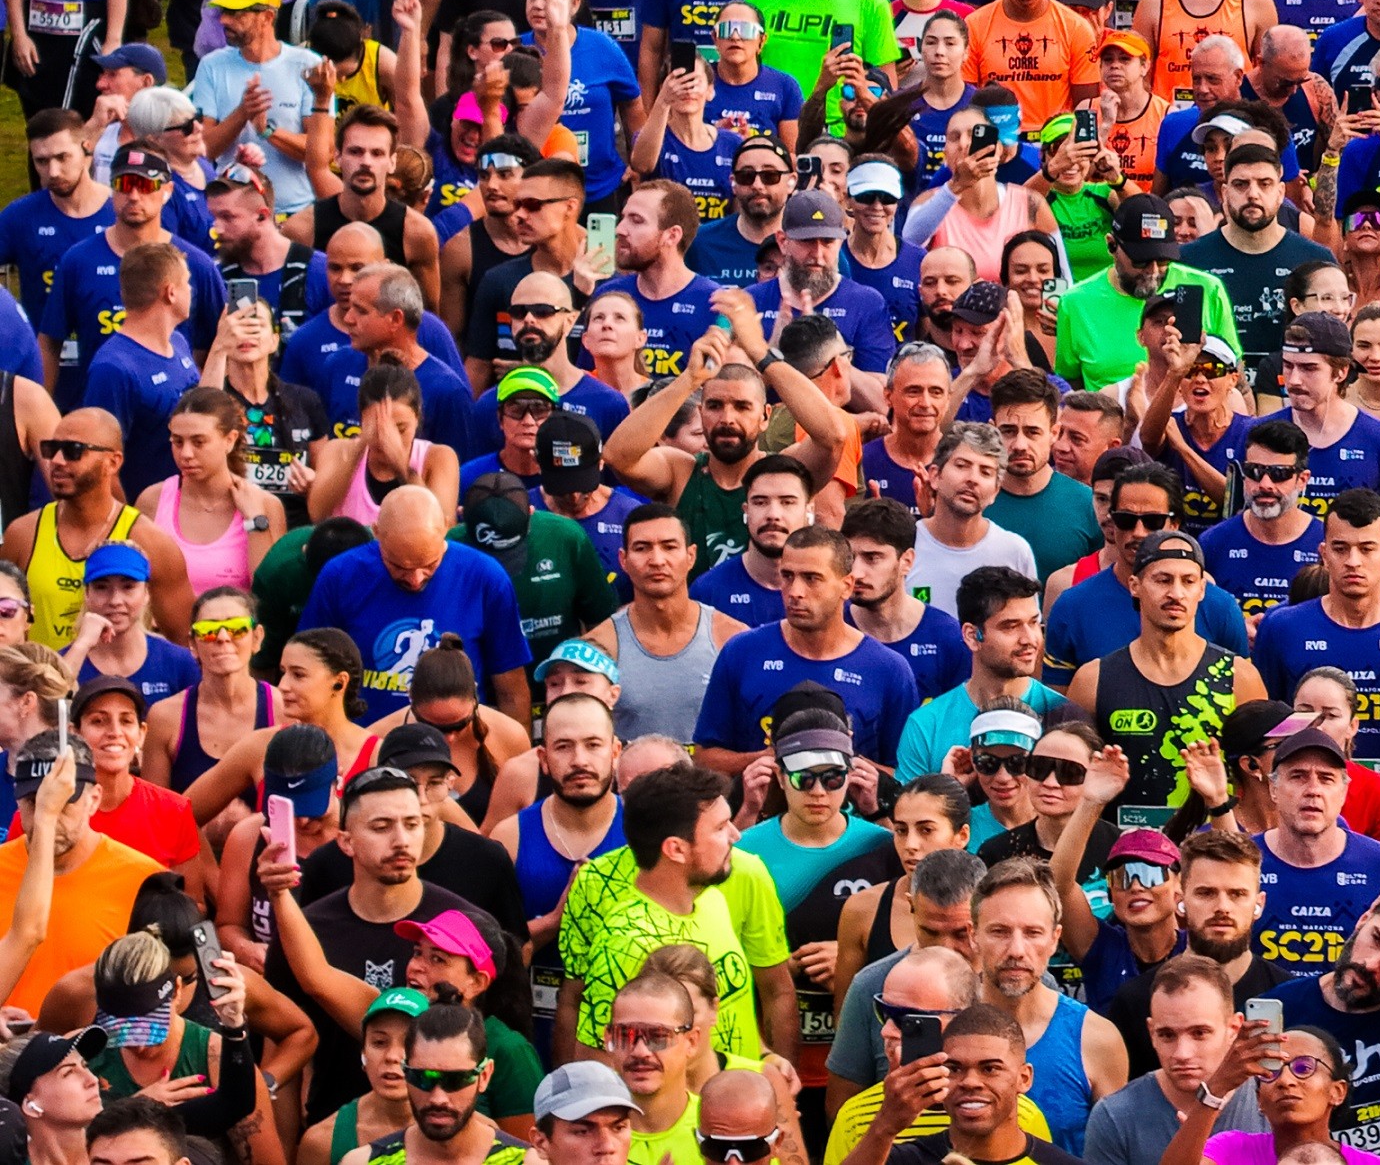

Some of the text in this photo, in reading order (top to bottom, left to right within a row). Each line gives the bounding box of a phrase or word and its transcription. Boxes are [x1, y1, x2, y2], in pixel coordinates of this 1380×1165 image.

[1008, 56, 1039, 69] CORRE
[686, 178, 715, 187] CAIXA
[1307, 477, 1334, 486] AIXA
[1229, 549, 1247, 558] RVB
[1254, 577, 1288, 587] CAIXA
[730, 594, 749, 603] RVB
[1305, 641, 1327, 650] RVB
[763, 660, 783, 670] RVB
[1346, 671, 1375, 680] AIXA
[31, 761, 54, 776] LIV
[1259, 873, 1277, 884] VB
[1291, 906, 1331, 917] CAIXA
[1260, 931, 1346, 962] SC21
